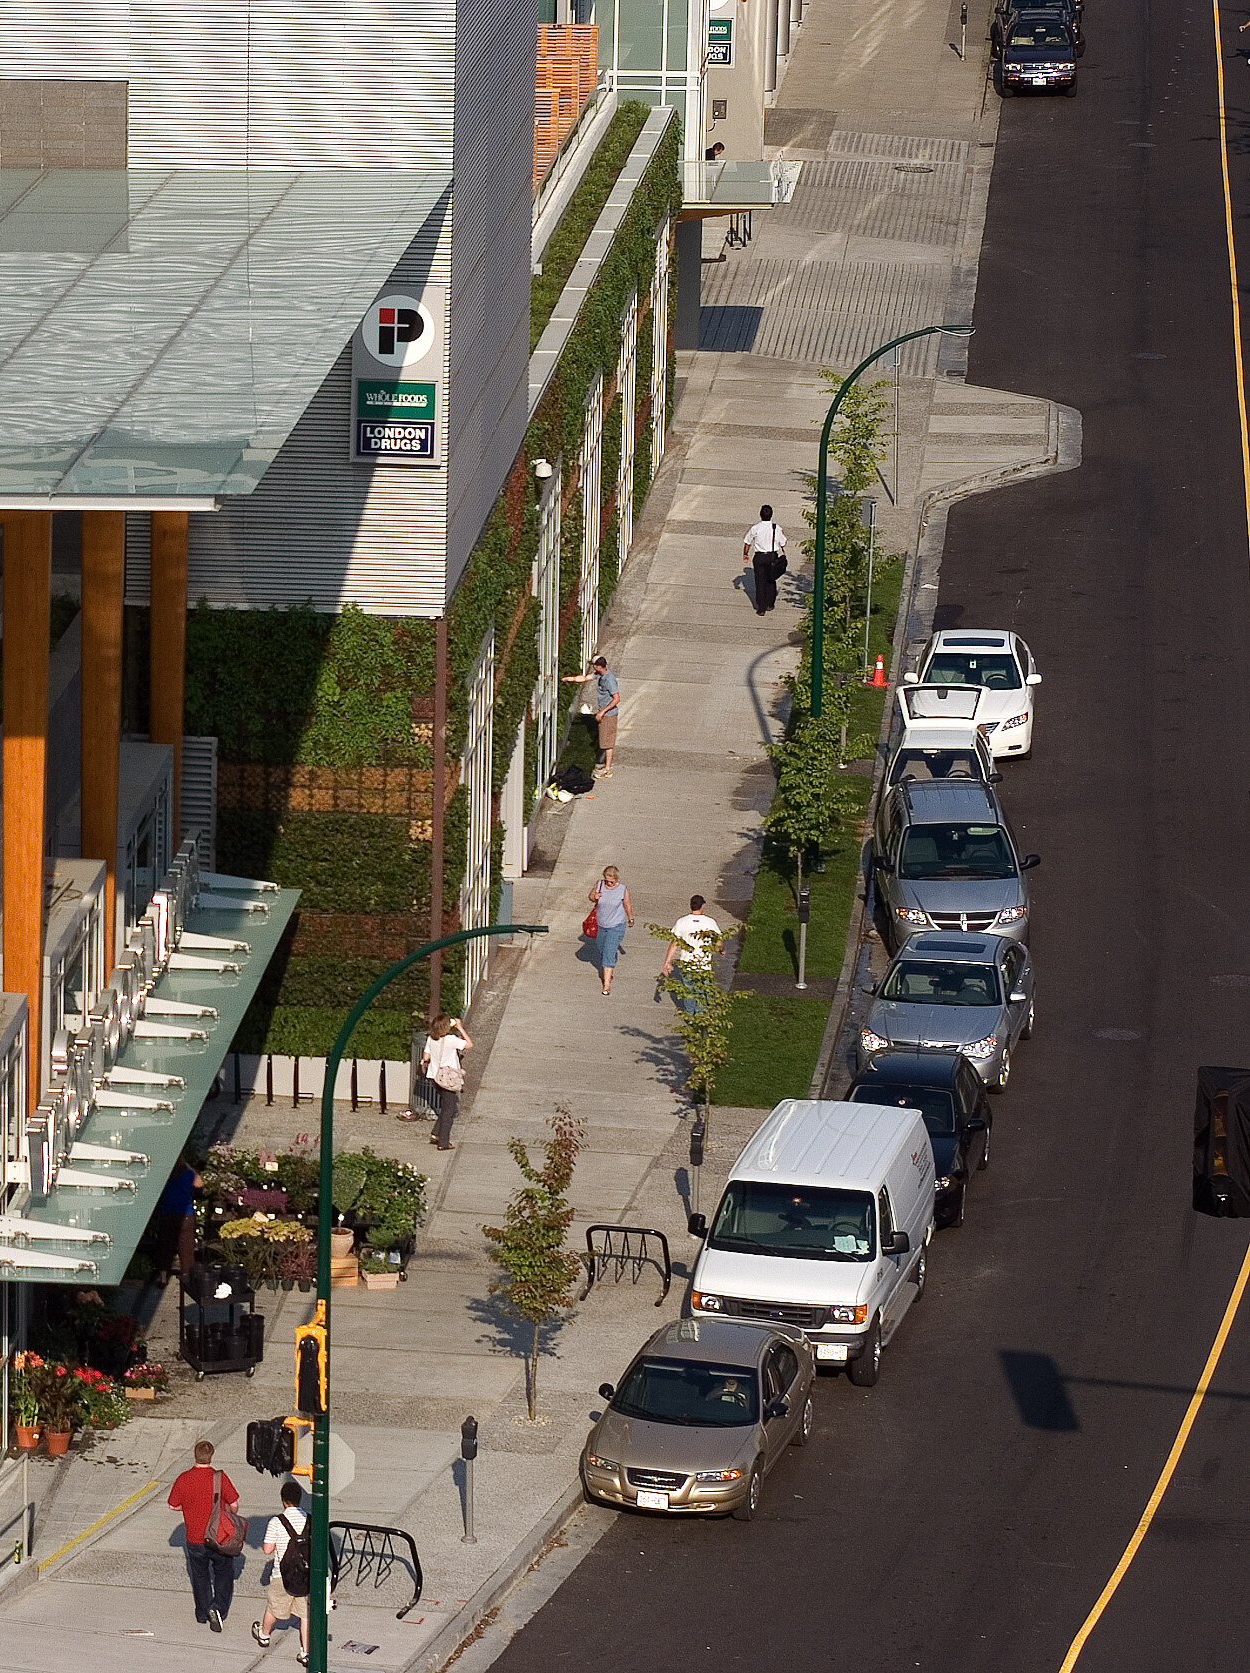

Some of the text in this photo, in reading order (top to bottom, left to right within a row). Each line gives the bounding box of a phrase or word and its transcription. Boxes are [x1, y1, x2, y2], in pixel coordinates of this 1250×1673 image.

[366, 392, 428, 403] WHOLE FOODS
[366, 427, 426, 440] LONDON
[371, 438, 421, 451] DRUGS
